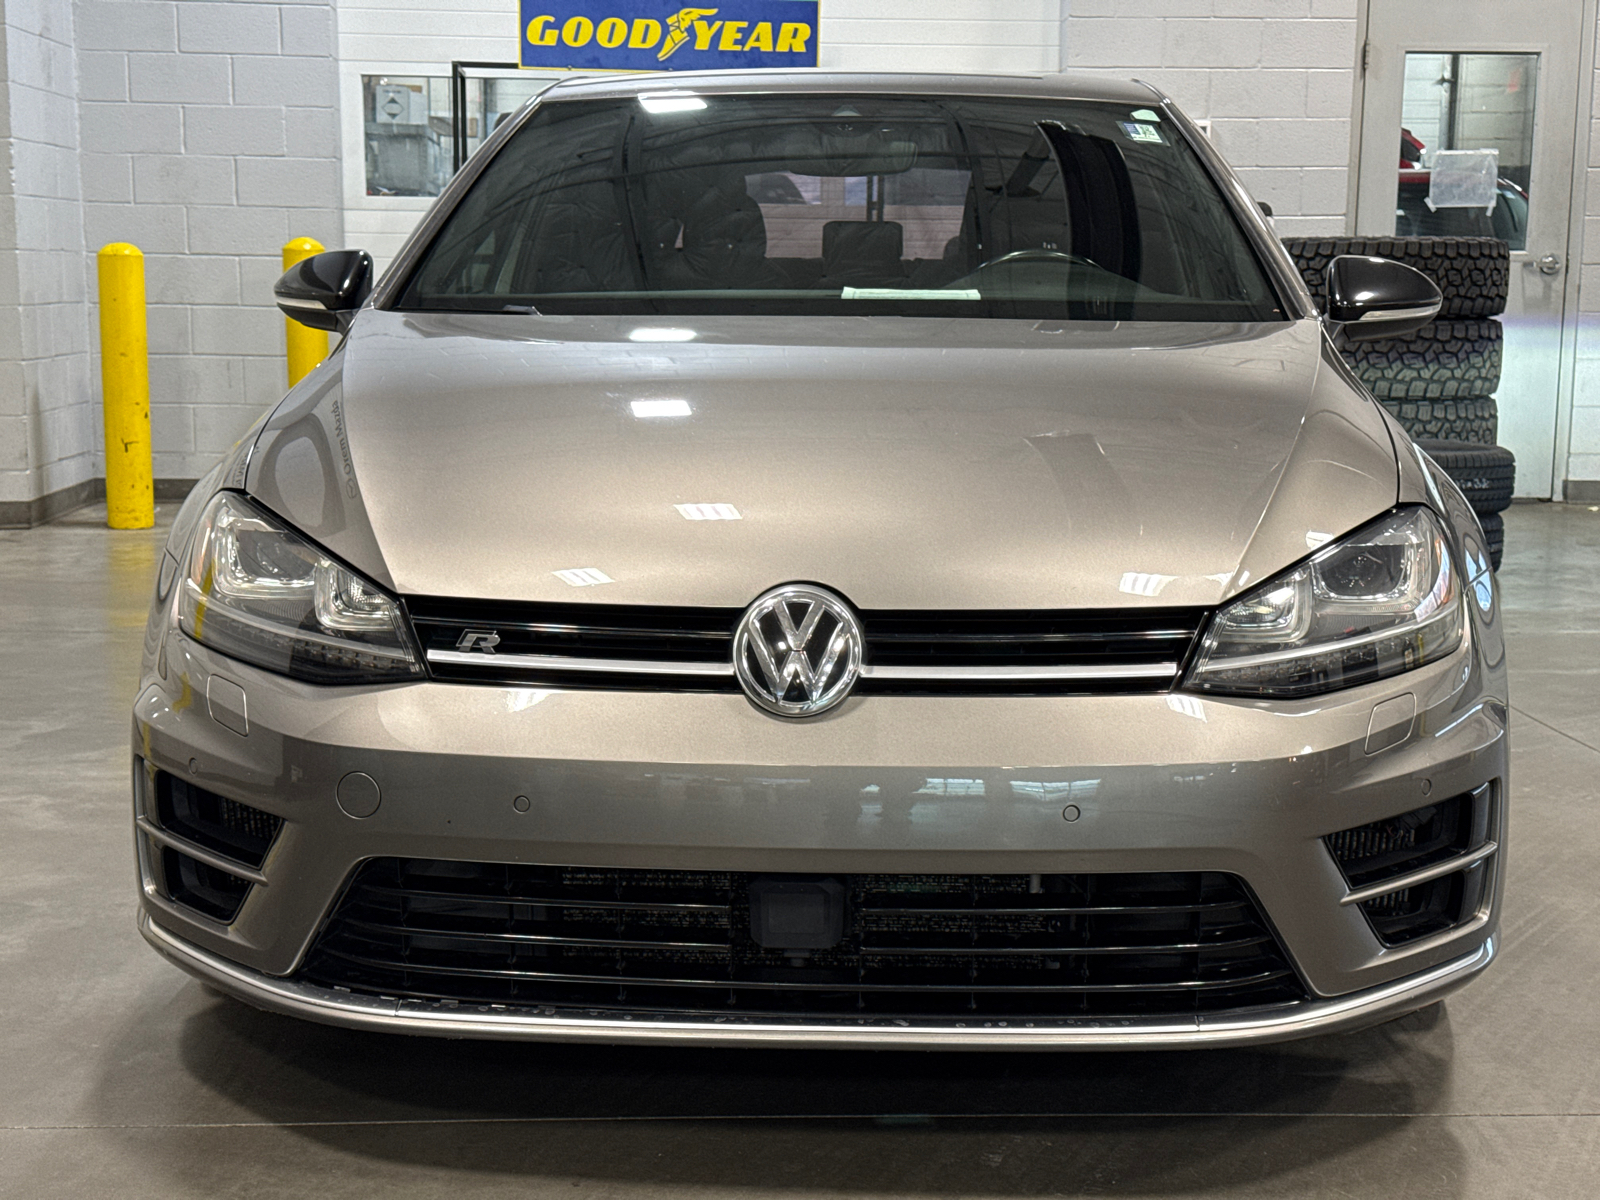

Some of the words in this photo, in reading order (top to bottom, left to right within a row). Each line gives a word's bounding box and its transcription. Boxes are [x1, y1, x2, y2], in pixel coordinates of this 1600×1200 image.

[331, 400, 343, 440] Mazda
[340, 439, 351, 475] Orem
[455, 628, 501, 654] R
